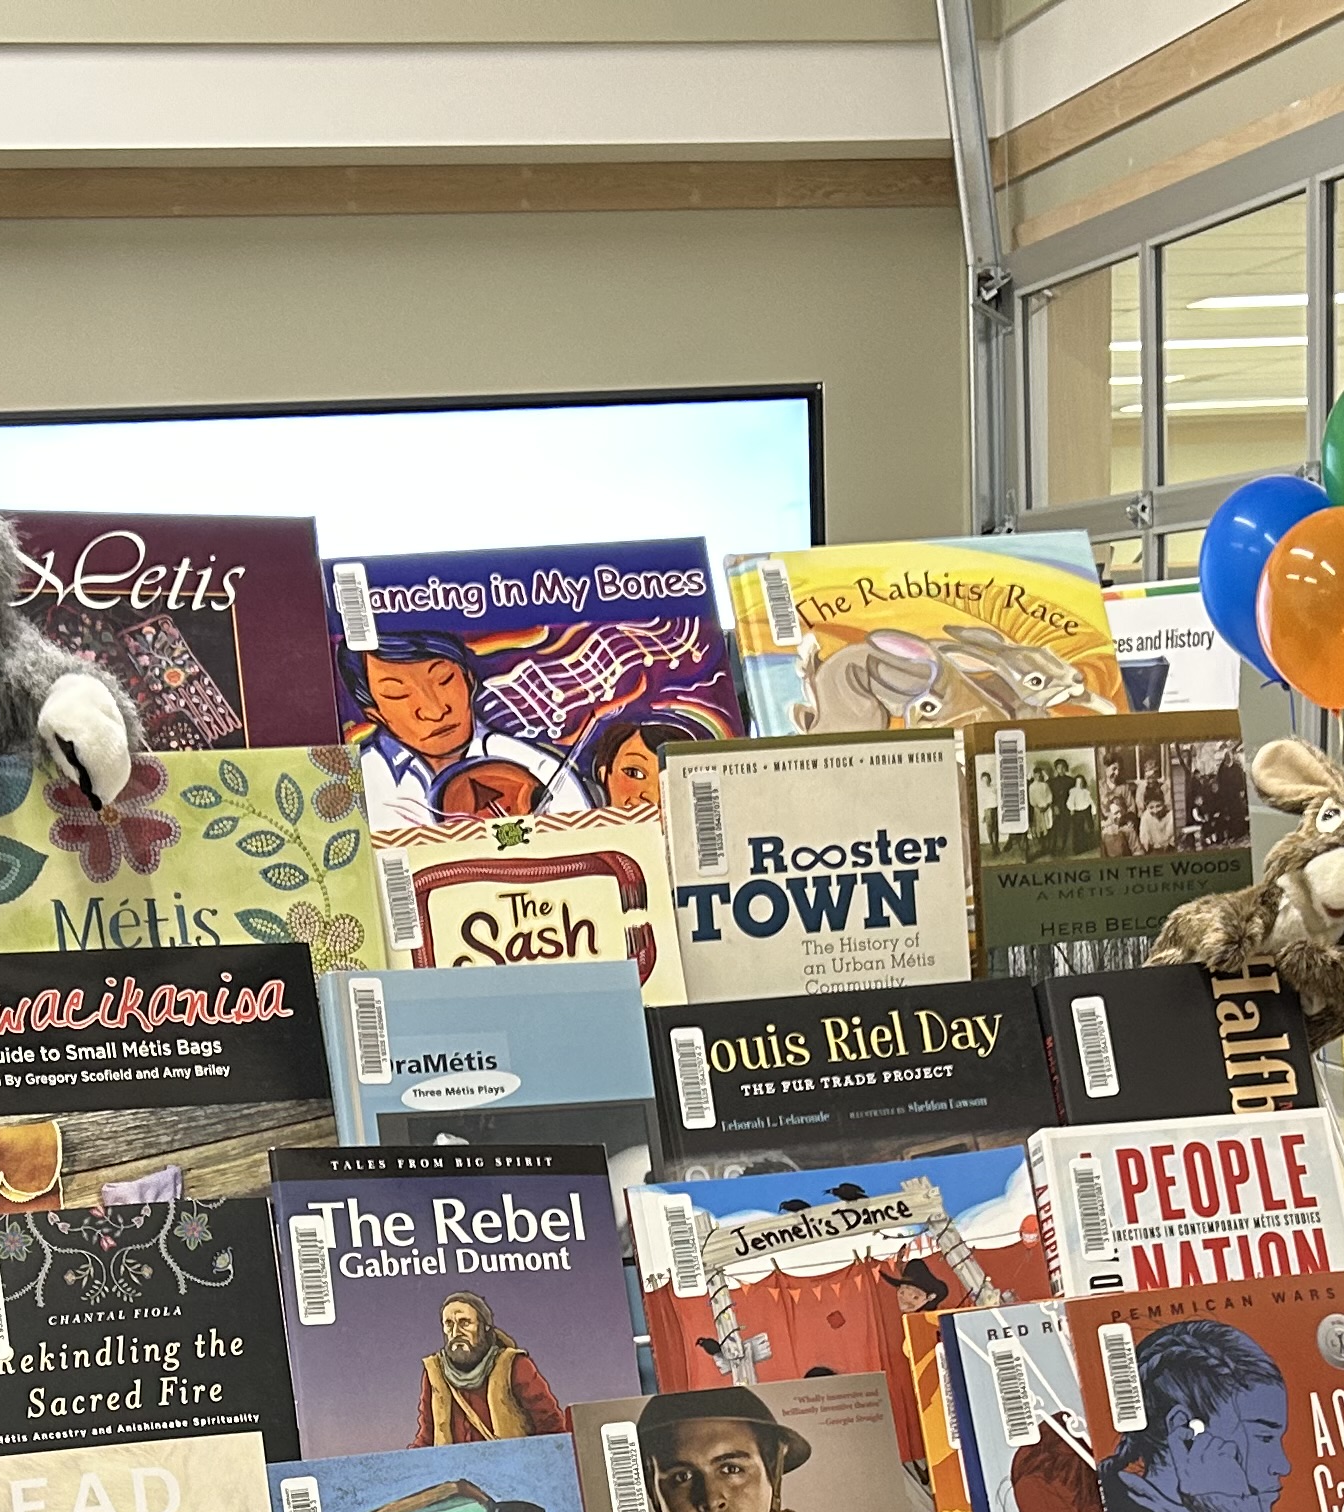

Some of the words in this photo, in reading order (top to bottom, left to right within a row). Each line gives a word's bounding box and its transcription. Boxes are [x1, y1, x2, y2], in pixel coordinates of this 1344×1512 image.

[492, 570, 523, 604] in
[531, 570, 589, 610] My
[602, 567, 706, 602] Bones
[795, 594, 852, 630] The
[855, 571, 994, 607] Rabbits'
[1004, 584, 1079, 636] Race
[1136, 633, 1163, 651] and
[1165, 628, 1215, 651] History
[723, 763, 758, 777] PETERS
[774, 759, 818, 773] MATTHEW
[823, 757, 854, 770] STOCK
[869, 754, 903, 767] ADRIAN
[908, 751, 944, 764] WERNER
[51, 892, 224, 951] Métis
[499, 892, 553, 926] The
[677, 869, 919, 942] TOWN
[453, 904, 599, 967] Sash
[802, 940, 834, 956] The
[840, 936, 899, 954] History
[904, 932, 920, 948] of
[803, 962, 826, 975] an
[832, 957, 885, 973] Urban
[891, 953, 936, 969] Métis
[40, 1043, 60, 1062] to
[65, 1041, 117, 1062] Small
[122, 1038, 172, 1058] Métis
[177, 1037, 222, 1059] Bags
[821, 1010, 908, 1064] Riel
[914, 1009, 1003, 1059] Day
[741, 1082, 776, 1098] THE
[782, 1078, 815, 1094] FUR
[820, 1072, 877, 1089] TRADE
[883, 1064, 954, 1083] PROJECT
[330, 1159, 386, 1171] TALES
[398, 1157, 444, 1170] FROM
[455, 1157, 485, 1169] BIG
[495, 1156, 554, 1168] SPIRIT
[1115, 1134, 1318, 1225] PEOPLE
[307, 1198, 415, 1250] The
[432, 1192, 586, 1245] Rebel
[730, 1216, 840, 1256] Jenneli's
[834, 1200, 913, 1232] Dance
[1165, 1225, 1175, 1238] IN
[1178, 1217, 1250, 1238] CONTEMPORARY
[1253, 1213, 1281, 1230] MÉTIS
[1284, 1211, 1322, 1227] STUDIES
[339, 1247, 446, 1278] Gabriel
[455, 1246, 571, 1274] Dumont
[48, 1309, 125, 1326] CHANTAL
[134, 1305, 182, 1319] FIOLA
[1111, 1294, 1253, 1323] PEMMICAN
[1272, 1287, 1338, 1305] WARS
[195, 1328, 244, 1359] the
[987, 1323, 1029, 1341] RED
[27, 1379, 142, 1419] Sacred
[158, 1376, 223, 1407] Fire
[1310, 1391, 1336, 1457] A
